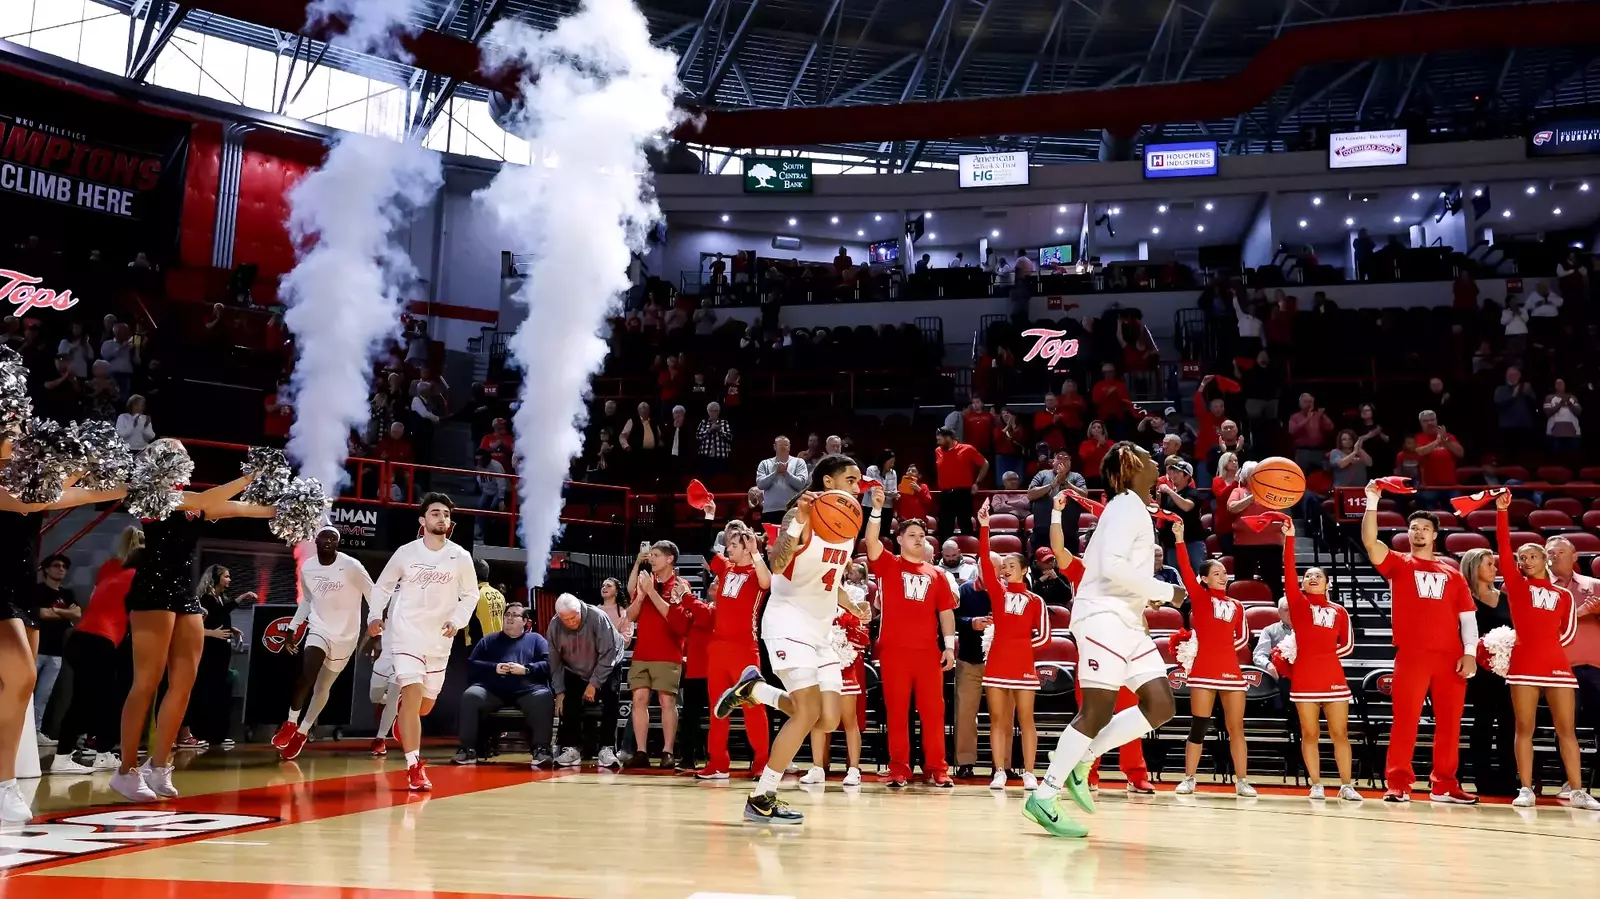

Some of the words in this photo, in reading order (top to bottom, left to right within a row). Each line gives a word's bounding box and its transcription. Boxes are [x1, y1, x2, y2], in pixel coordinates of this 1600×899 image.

[16, 116, 33, 127] WKU
[38, 123, 86, 141] ATHLETICS
[973, 154, 1015, 163] American
[1166, 152, 1211, 160] HOUCHENS
[1342, 144, 1376, 156] OVERHEAD
[1166, 159, 1211, 167] INDUSTRIES
[0, 163, 71, 202] CLIMB
[77, 181, 134, 216] HERE
[0, 268, 80, 317] Tops
[836, 496, 861, 518] ELITE
[1347, 497, 1368, 507] 113
[821, 547, 848, 565] WKU
[312, 575, 344, 596] Tops
[410, 563, 453, 589] Tops
[722, 571, 749, 599] W
[821, 568, 837, 592] 4
[902, 571, 932, 601] W
[1414, 570, 1448, 600] W
[485, 591, 501, 601] CSC
[1004, 591, 1029, 616] W
[1529, 585, 1561, 611] W
[1211, 596, 1237, 623] W
[1309, 604, 1338, 629] W
